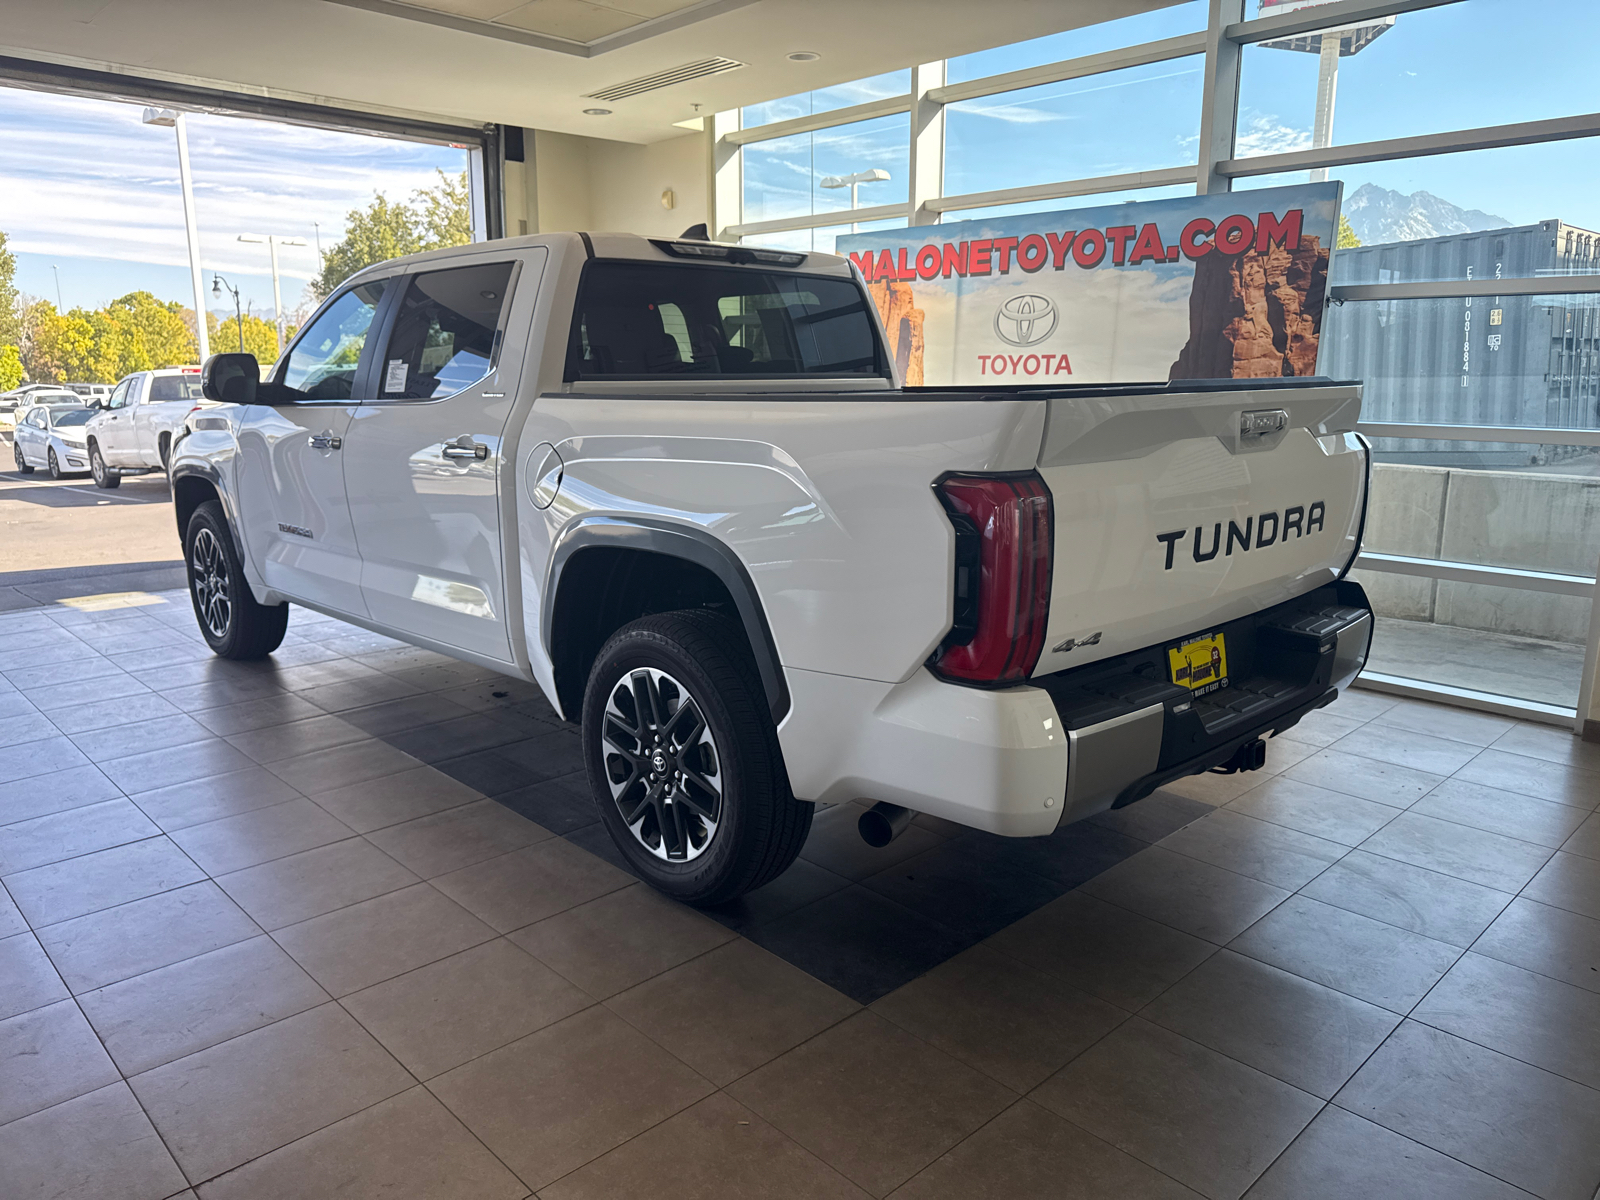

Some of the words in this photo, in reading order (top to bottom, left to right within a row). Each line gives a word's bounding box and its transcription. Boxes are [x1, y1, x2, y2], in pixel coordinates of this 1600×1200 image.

[850, 209, 1304, 283] MALONETOYOTA.COM
[977, 354, 1073, 376] TOYOTA
[1156, 500, 1326, 570] TUNDRA
[1212, 650, 1218, 660] 32
[1195, 688, 1205, 697] MAKE
[1210, 682, 1219, 692] EASY
